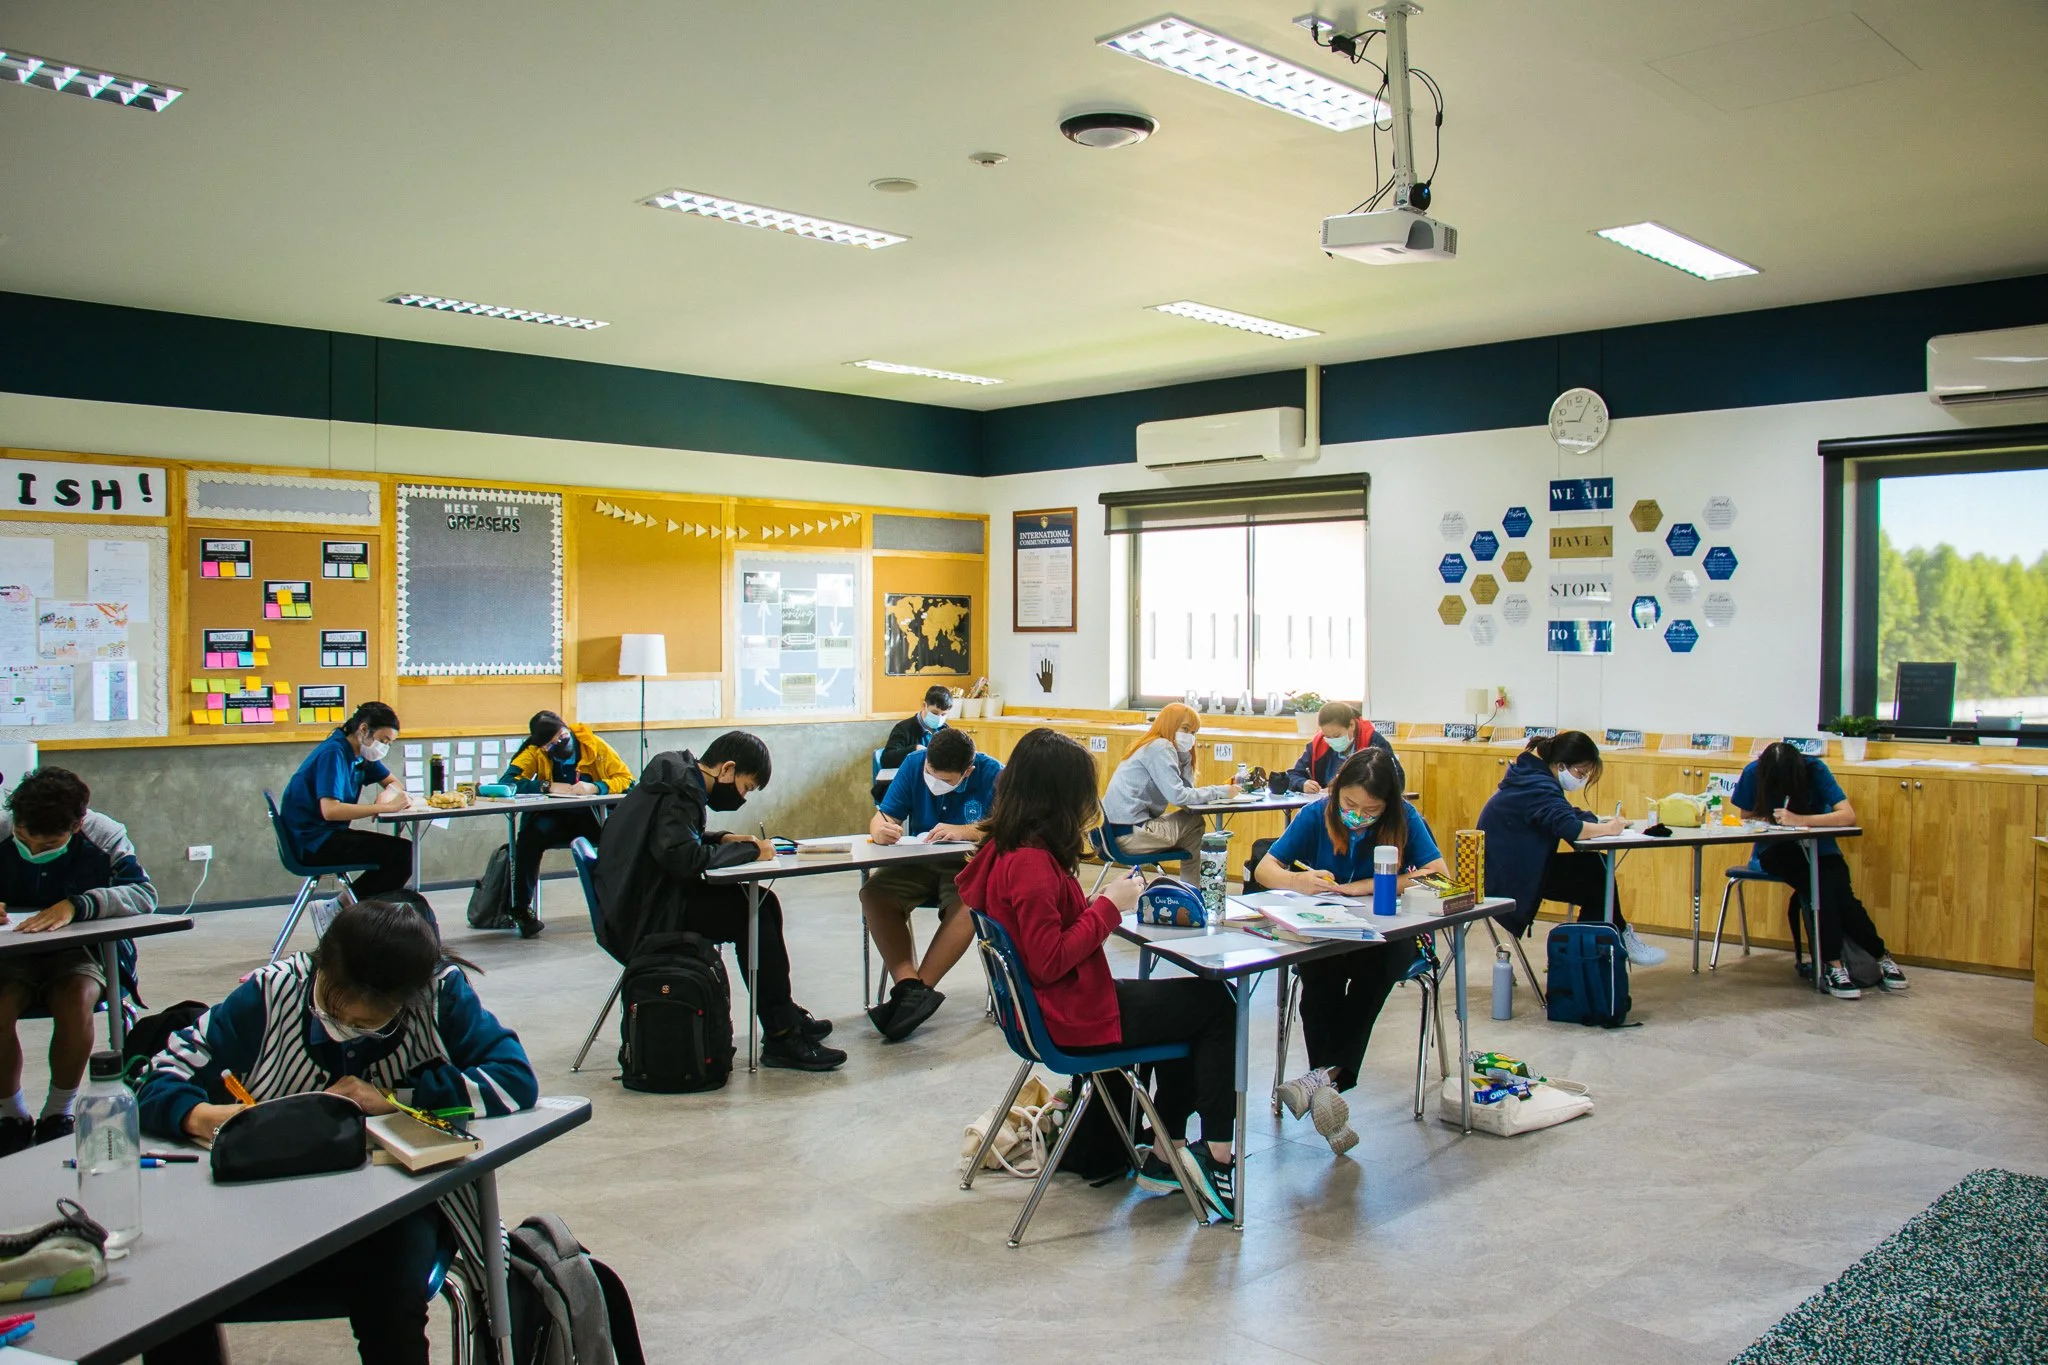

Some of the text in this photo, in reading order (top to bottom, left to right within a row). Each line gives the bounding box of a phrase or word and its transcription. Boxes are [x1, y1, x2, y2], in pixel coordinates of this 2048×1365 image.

[1551, 486, 1612, 501] WE ALL
[443, 503, 519, 517] MEET THE
[446, 514, 521, 533] GREASERS
[1019, 530, 1070, 540] INTERNATIONAL
[1019, 537, 1070, 546] COMMUNITY SCHOOL
[1552, 535, 1610, 548] HAVE A
[1550, 582, 1611, 597] STORY
[1549, 629, 1611, 641] TO TELL
[1184, 689, 1284, 716] READ
